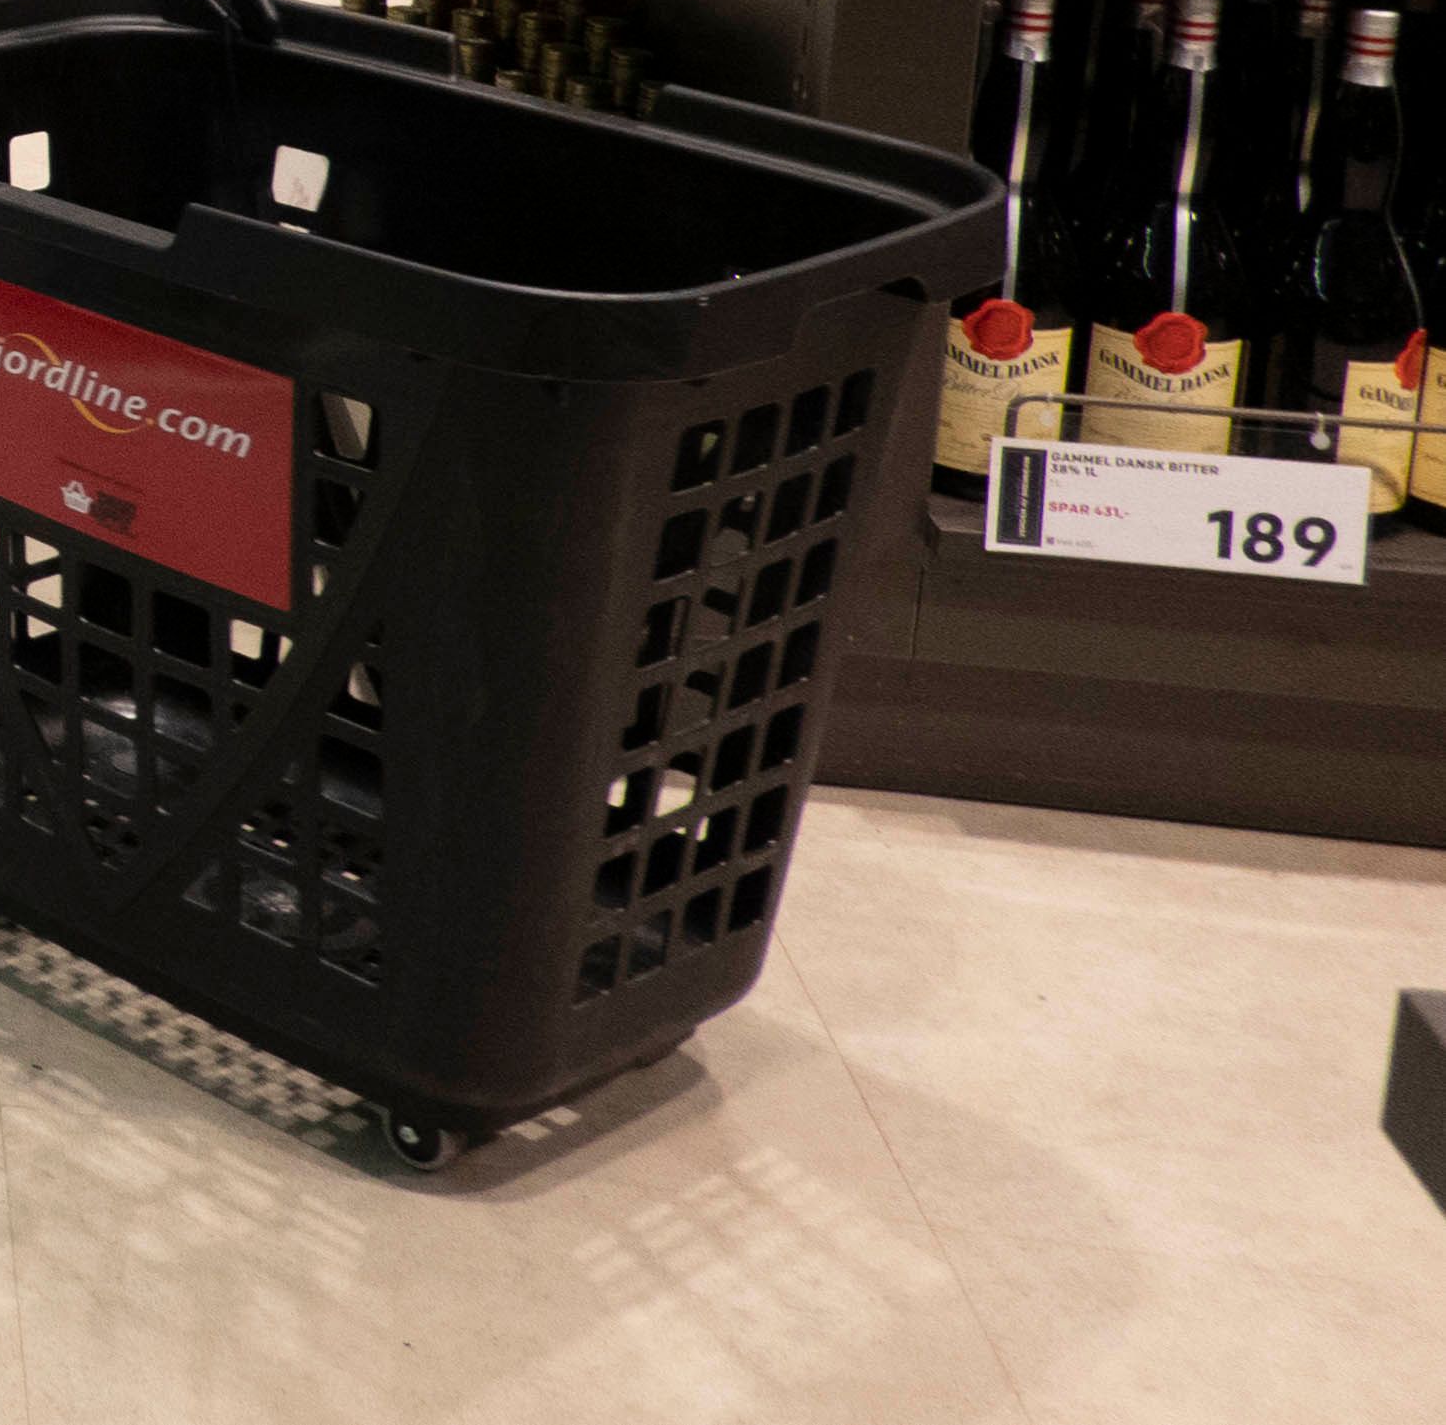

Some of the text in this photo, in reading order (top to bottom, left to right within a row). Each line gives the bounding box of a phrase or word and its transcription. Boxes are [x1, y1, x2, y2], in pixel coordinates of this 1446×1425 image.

[1098, 346, 1176, 394] GAMMEL
[1049, 464, 1082, 477] 38%
[1050, 451, 1219, 476] GAMMEL DANSK BITTER
[1048, 500, 1091, 516] SPAR
[1208, 509, 1338, 569] 189
